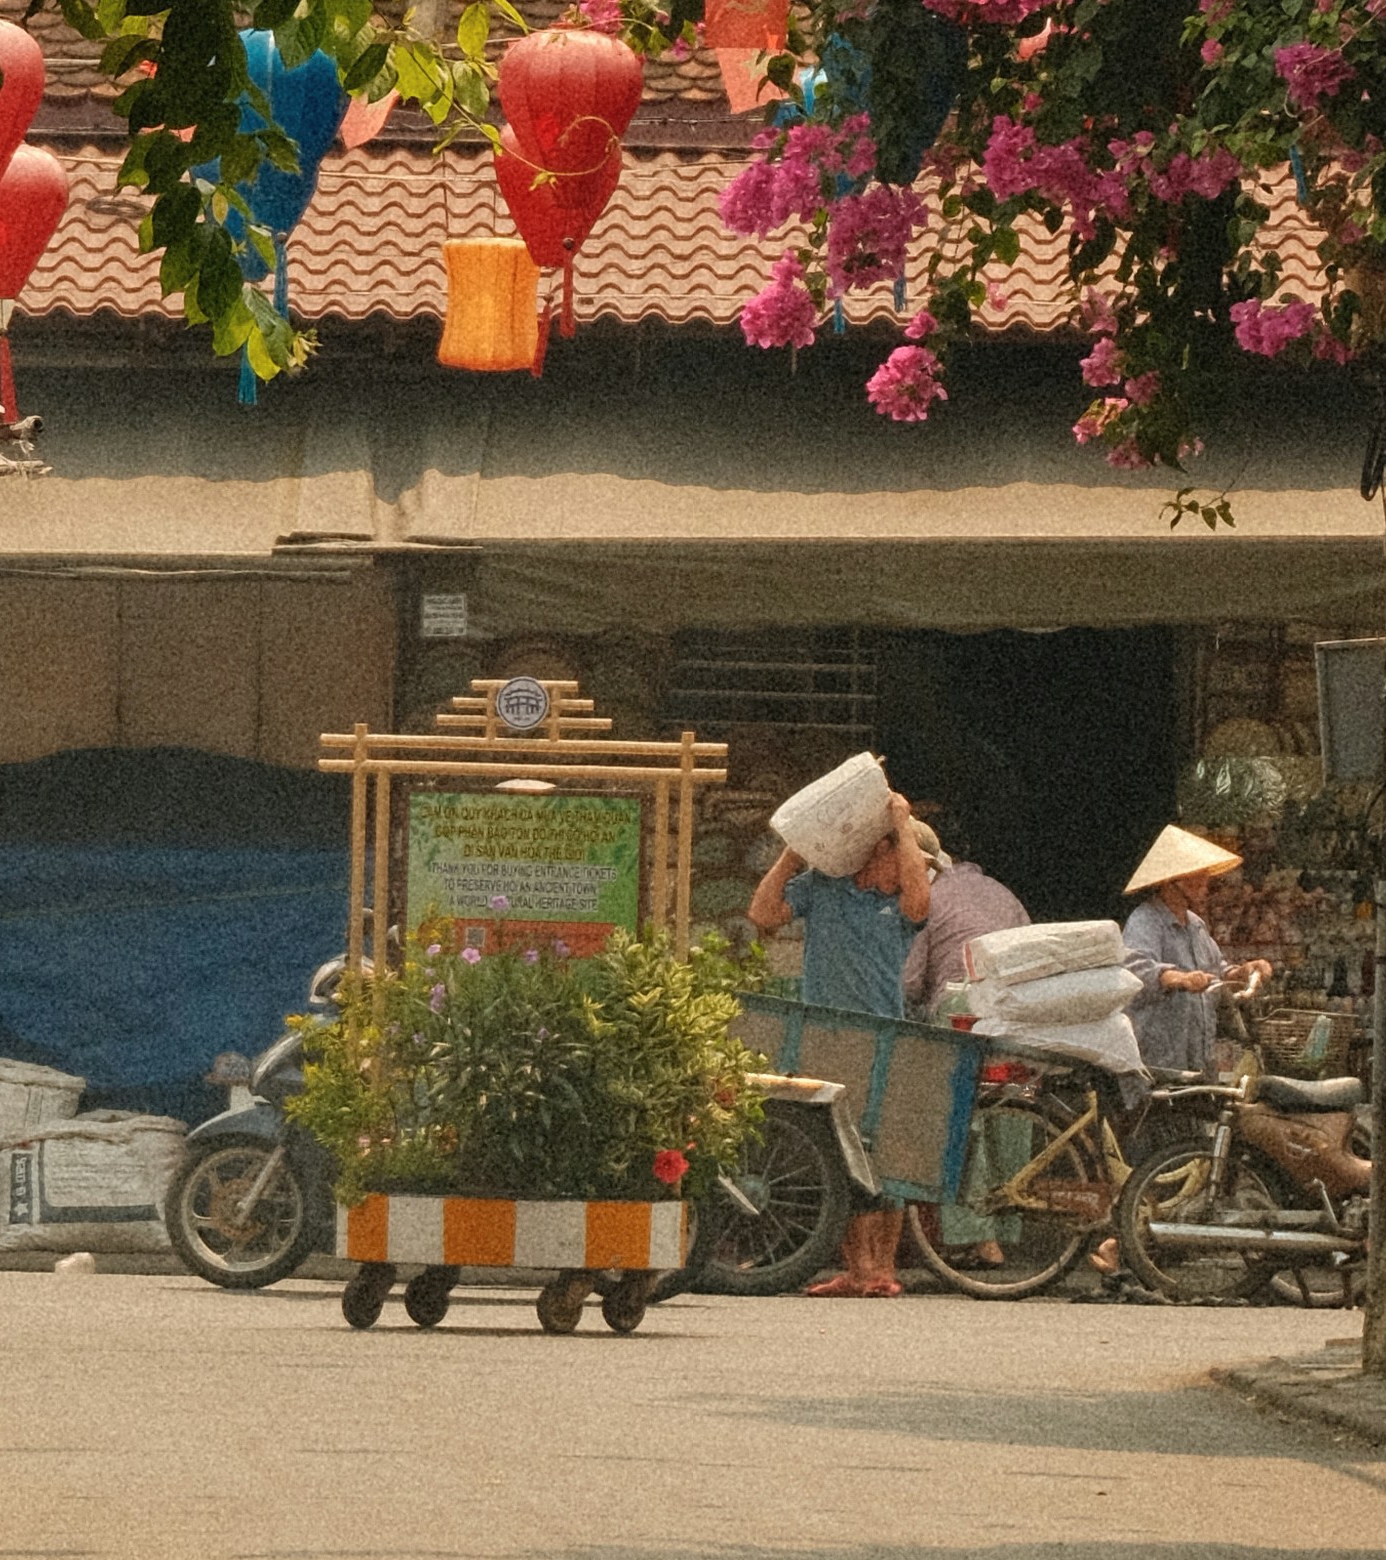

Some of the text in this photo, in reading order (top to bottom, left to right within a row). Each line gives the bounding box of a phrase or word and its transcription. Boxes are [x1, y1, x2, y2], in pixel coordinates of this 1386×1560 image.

[431, 861, 618, 881] THANK YOU FOR BUYING ENTRANCE TICKETS
[444, 877, 456, 891] TO
[457, 878, 502, 892] PRESERVE
[533, 882, 570, 894] ANCIENT
[572, 882, 597, 896] TOWN
[457, 895, 488, 908] WORLD
[535, 897, 579, 911] HERITAGE
[579, 898, 598, 912] SITE
